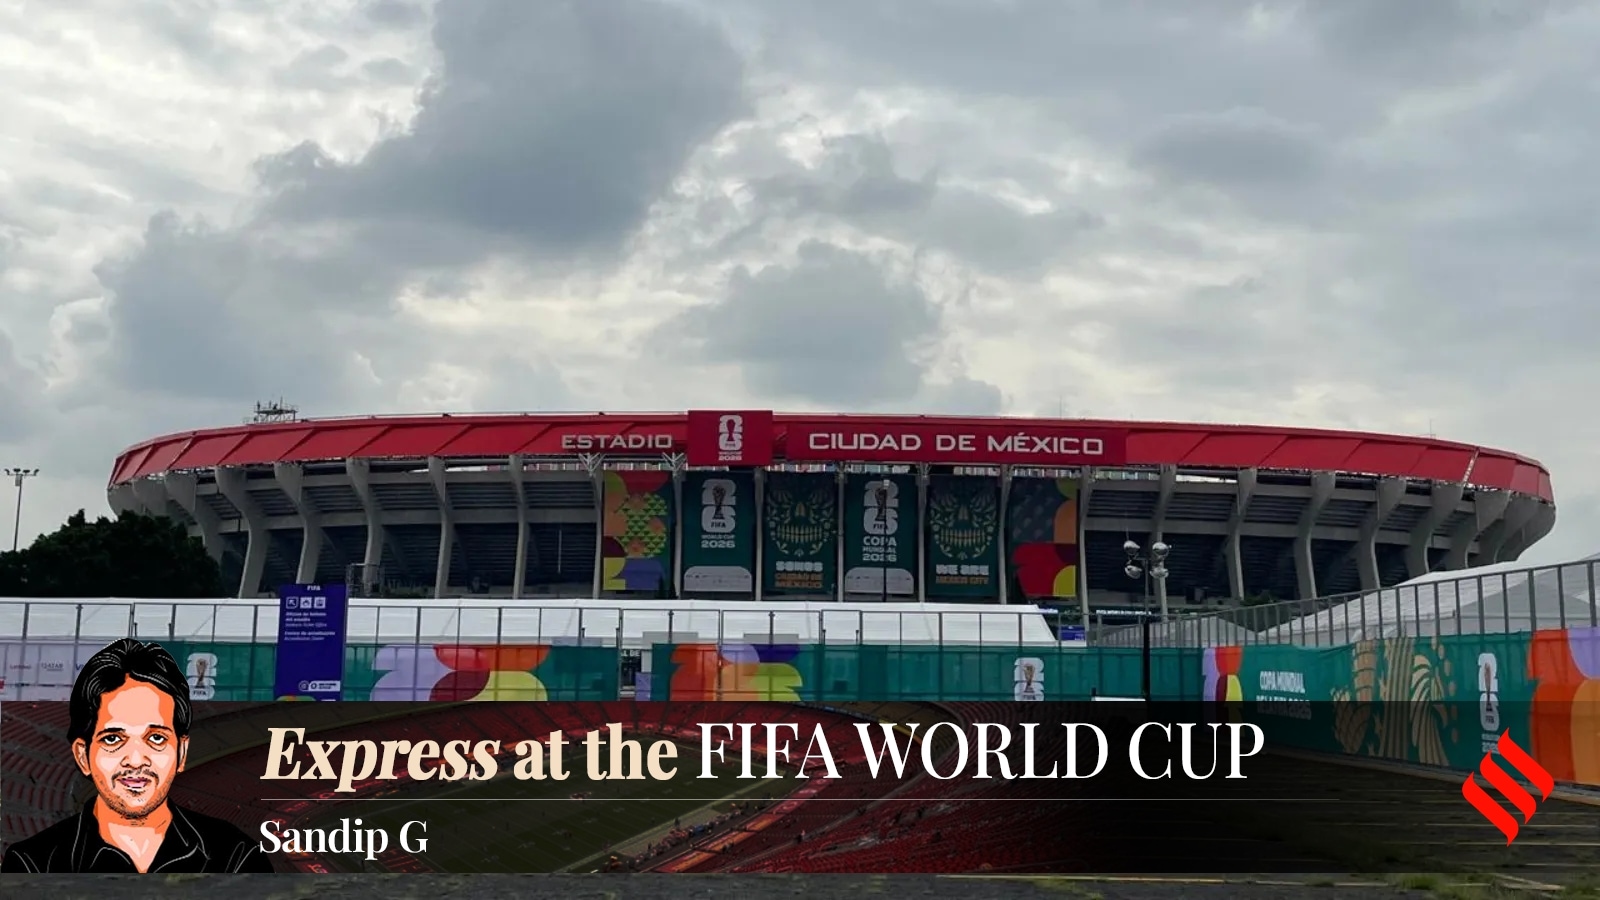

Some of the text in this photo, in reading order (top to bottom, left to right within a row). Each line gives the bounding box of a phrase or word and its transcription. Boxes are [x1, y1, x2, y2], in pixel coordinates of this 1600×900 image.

[561, 434, 672, 449] ESTADIO
[809, 432, 1103, 455] CIUDAD DE MÉXICO
[711, 521, 726, 529] FIFA
[701, 540, 736, 548] 2026
[863, 536, 897, 546] COPA
